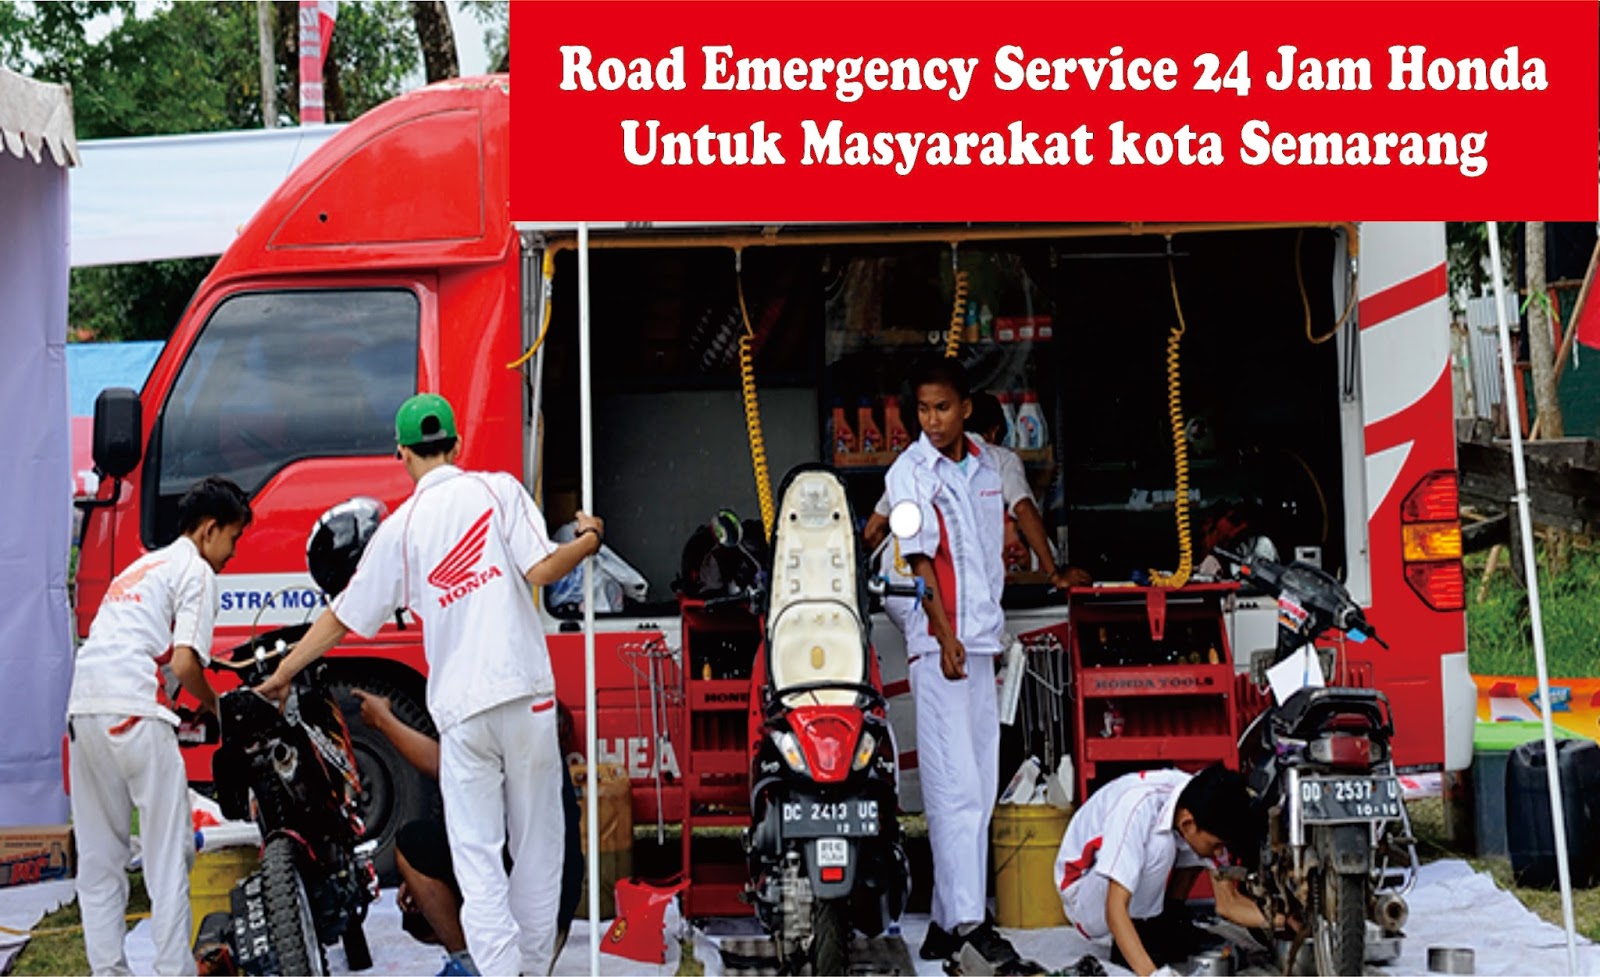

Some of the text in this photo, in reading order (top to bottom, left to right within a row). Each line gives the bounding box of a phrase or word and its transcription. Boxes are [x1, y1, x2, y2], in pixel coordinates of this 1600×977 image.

[1158, 676, 1214, 687] TOOLS
[1334, 781, 1371, 801] 2537
[783, 801, 878, 821] DC 2413 UC
